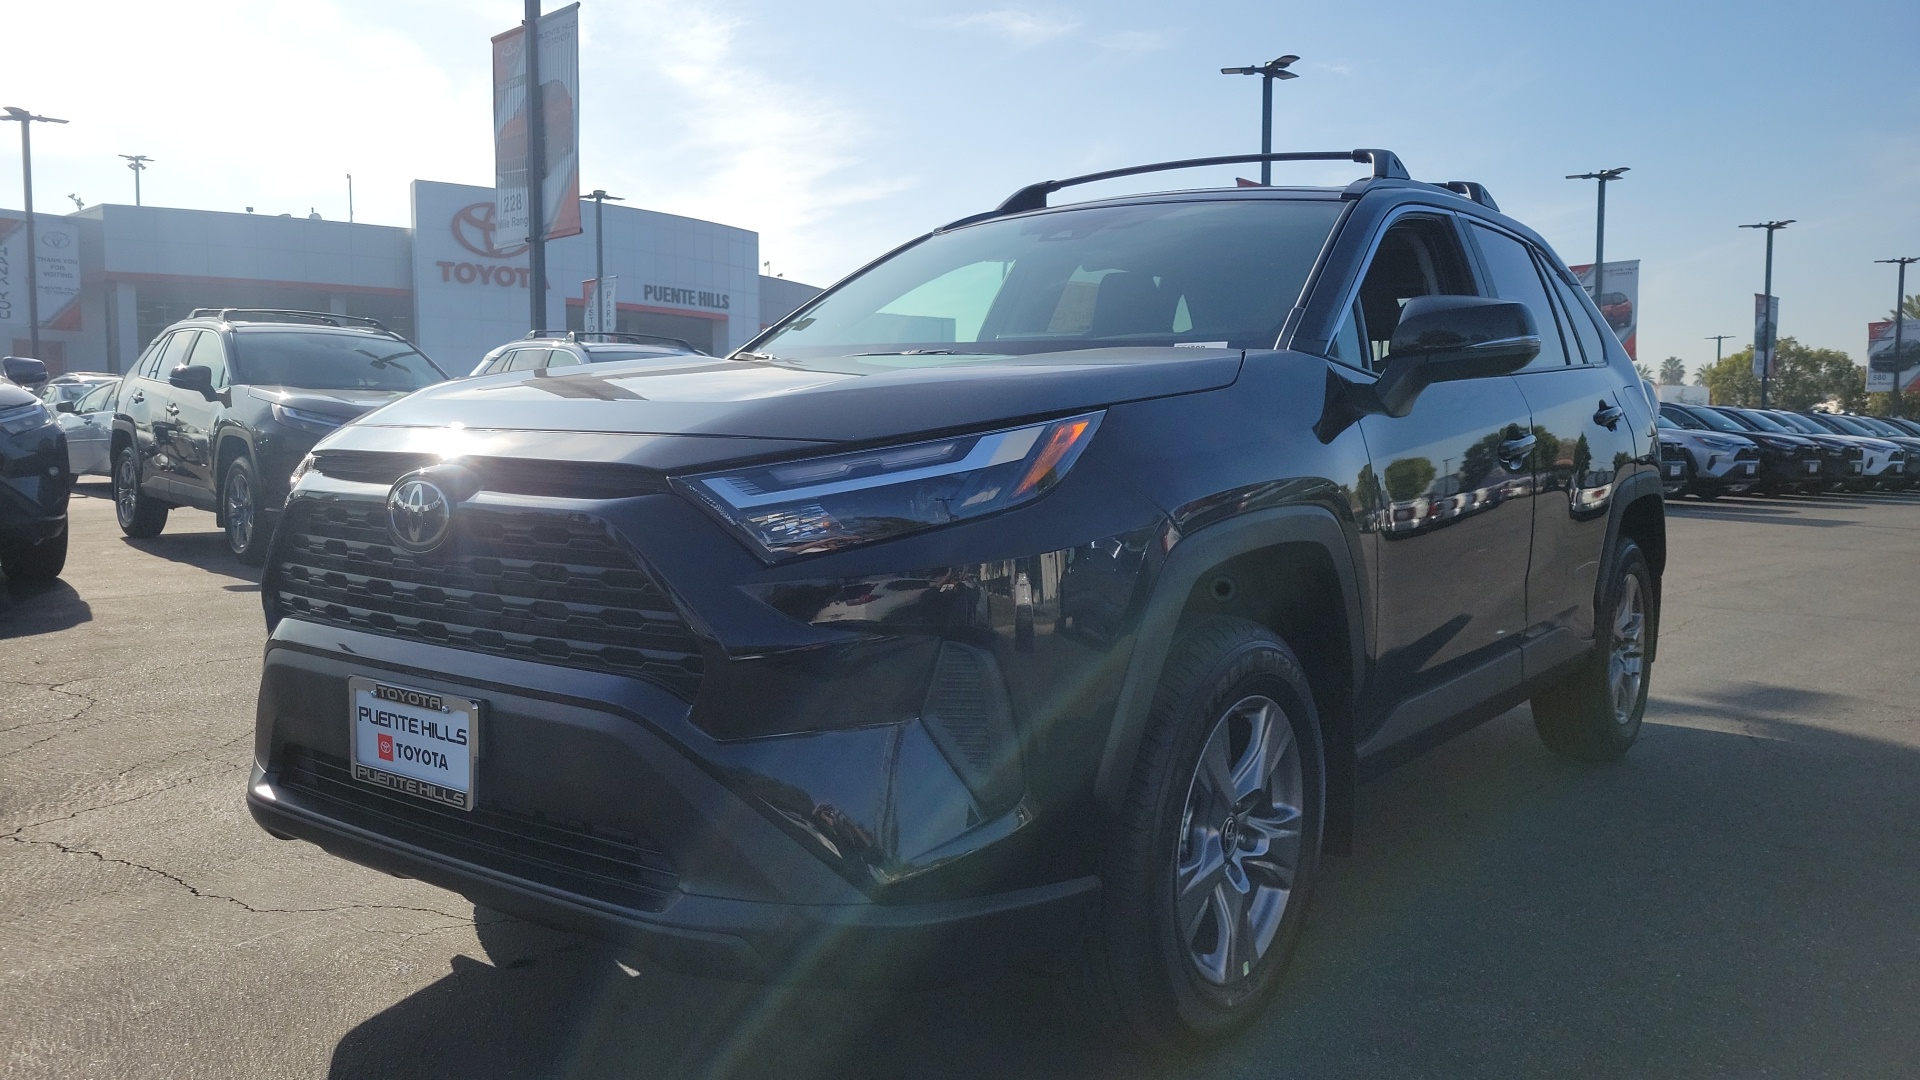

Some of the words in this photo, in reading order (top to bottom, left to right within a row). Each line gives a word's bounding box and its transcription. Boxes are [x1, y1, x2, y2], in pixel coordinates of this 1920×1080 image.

[503, 193, 522, 214] 228
[37, 256, 62, 264] THANK
[42, 271, 73, 279] VISITING
[436, 260, 551, 290] TOYOT
[643, 284, 696, 306] PUENTE
[698, 290, 730, 310] HILLS
[377, 685, 442, 709] TOYOTA
[358, 705, 419, 735] PUENTE
[421, 720, 468, 746] HILLS
[396, 742, 449, 771] TOYOTA
[357, 767, 417, 794] PUENTE
[419, 782, 465, 806] HILLS
